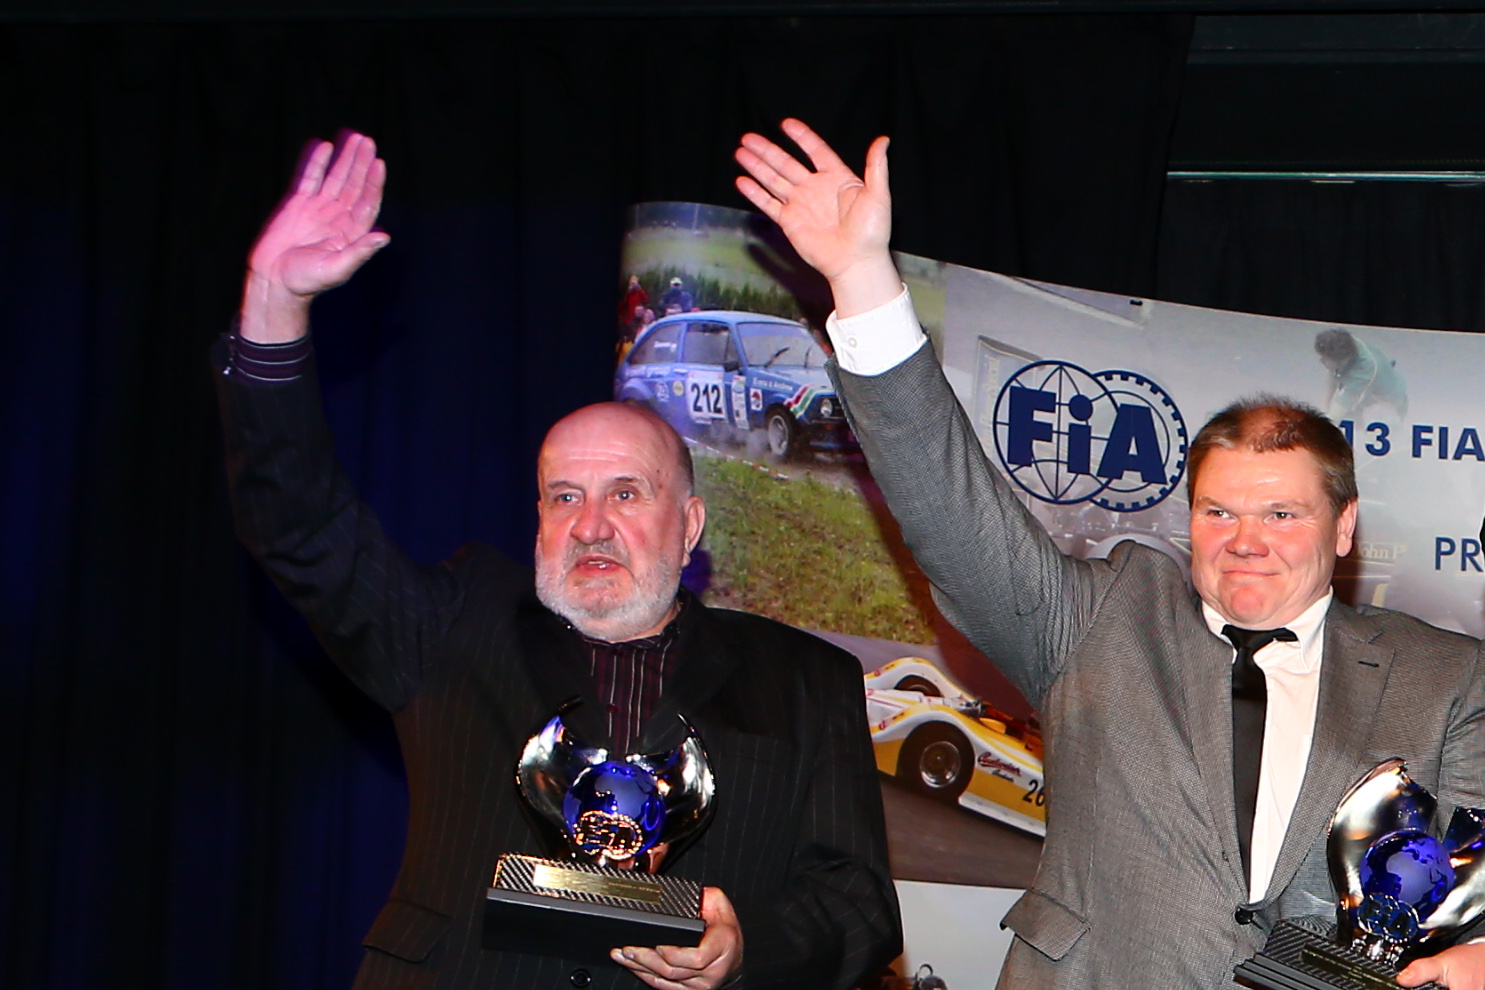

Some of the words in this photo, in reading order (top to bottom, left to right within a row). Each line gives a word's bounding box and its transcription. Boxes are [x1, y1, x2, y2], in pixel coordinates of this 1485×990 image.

[691, 384, 724, 415] 212
[1434, 536, 1484, 572] PR
[1023, 779, 1045, 807] 26
